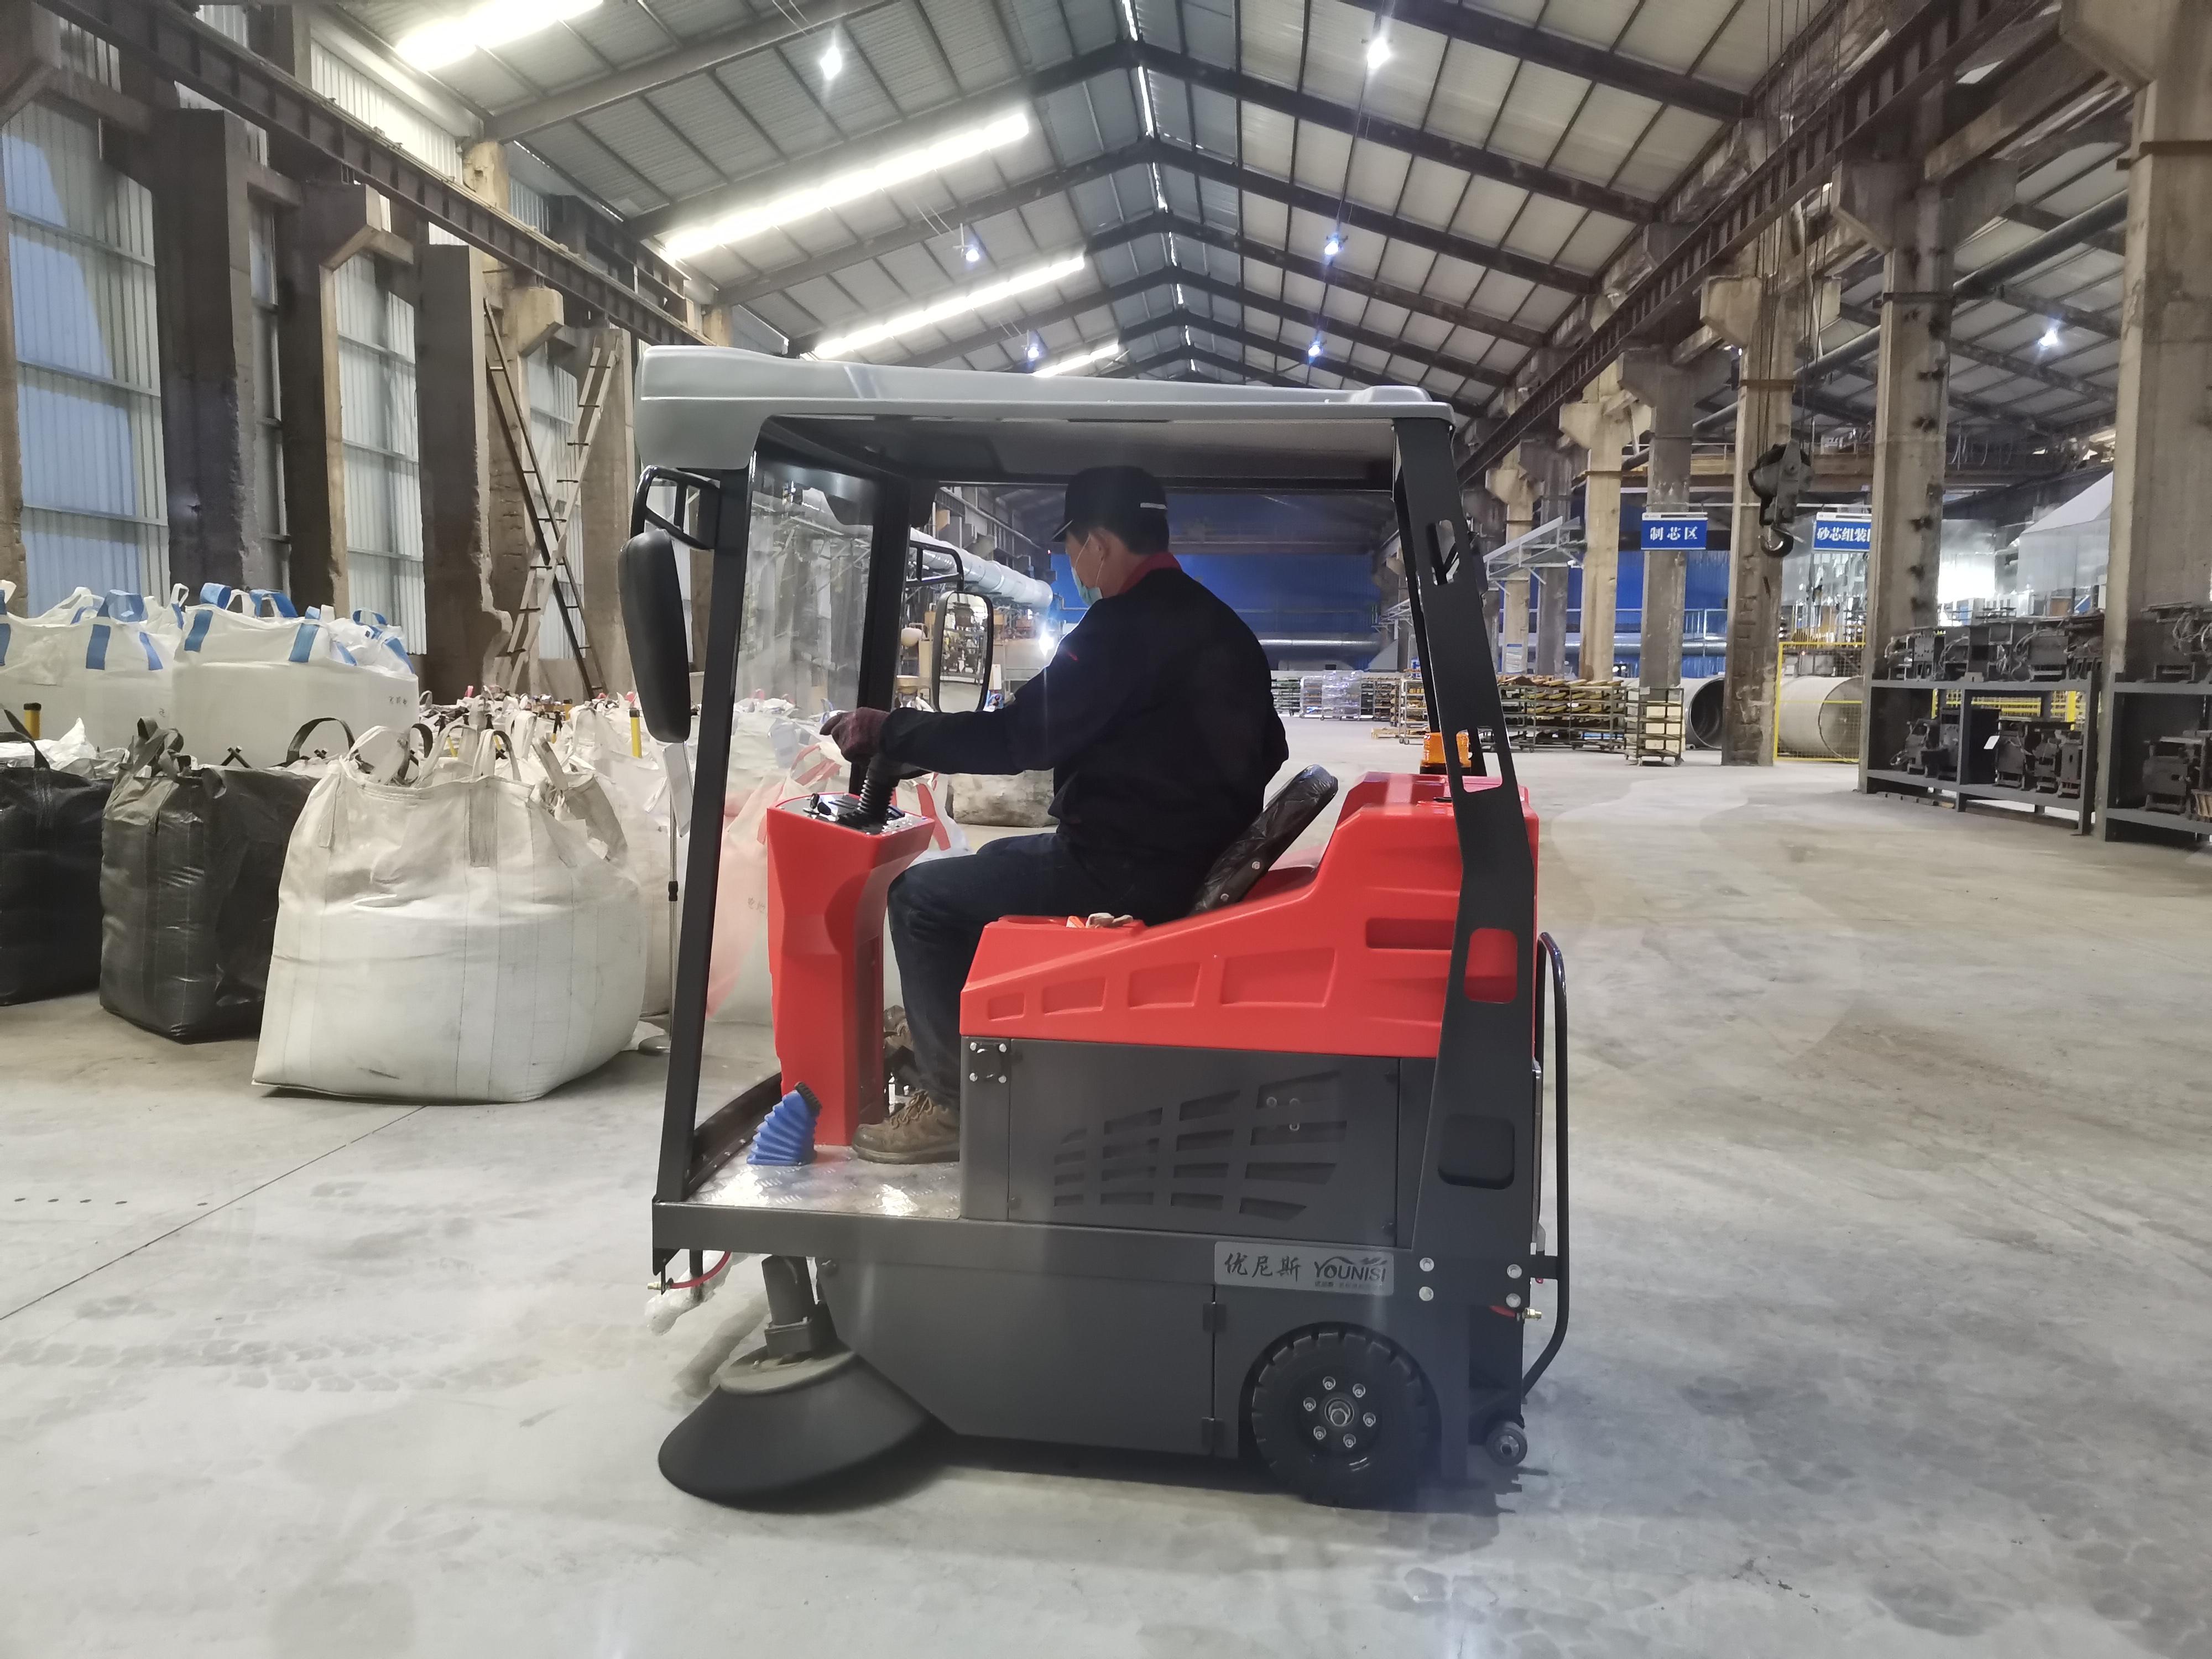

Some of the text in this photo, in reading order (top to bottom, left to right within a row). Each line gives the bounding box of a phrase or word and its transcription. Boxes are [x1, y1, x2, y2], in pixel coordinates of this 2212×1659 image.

[1650, 526, 1698, 541] 制芯区
[1817, 526, 1871, 542] 砂芯组装
[1224, 1252, 1301, 1282] 优尼斯
